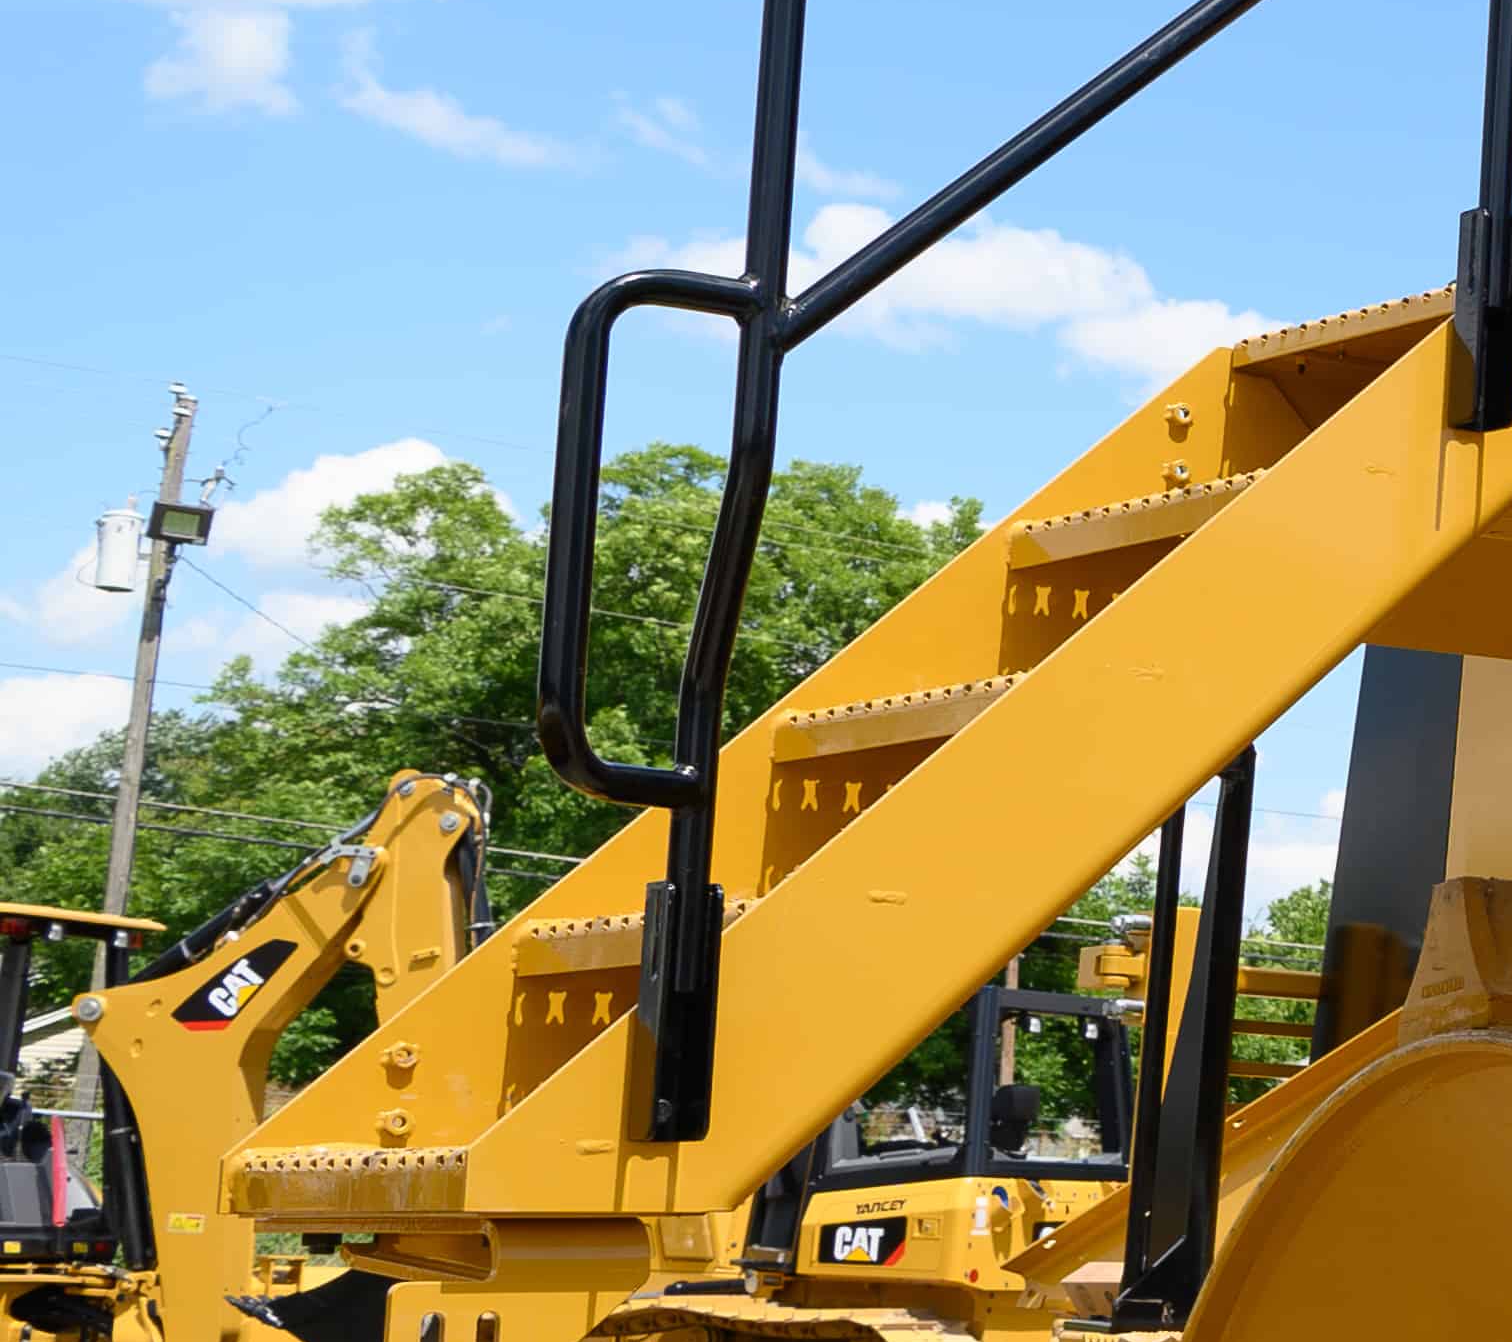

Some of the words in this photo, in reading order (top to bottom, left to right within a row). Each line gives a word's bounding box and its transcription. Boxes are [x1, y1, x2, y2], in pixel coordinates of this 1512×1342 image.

[208, 958, 265, 1017] CAT
[855, 1198, 908, 1215] YANCEY
[833, 1225, 885, 1263] CAT
